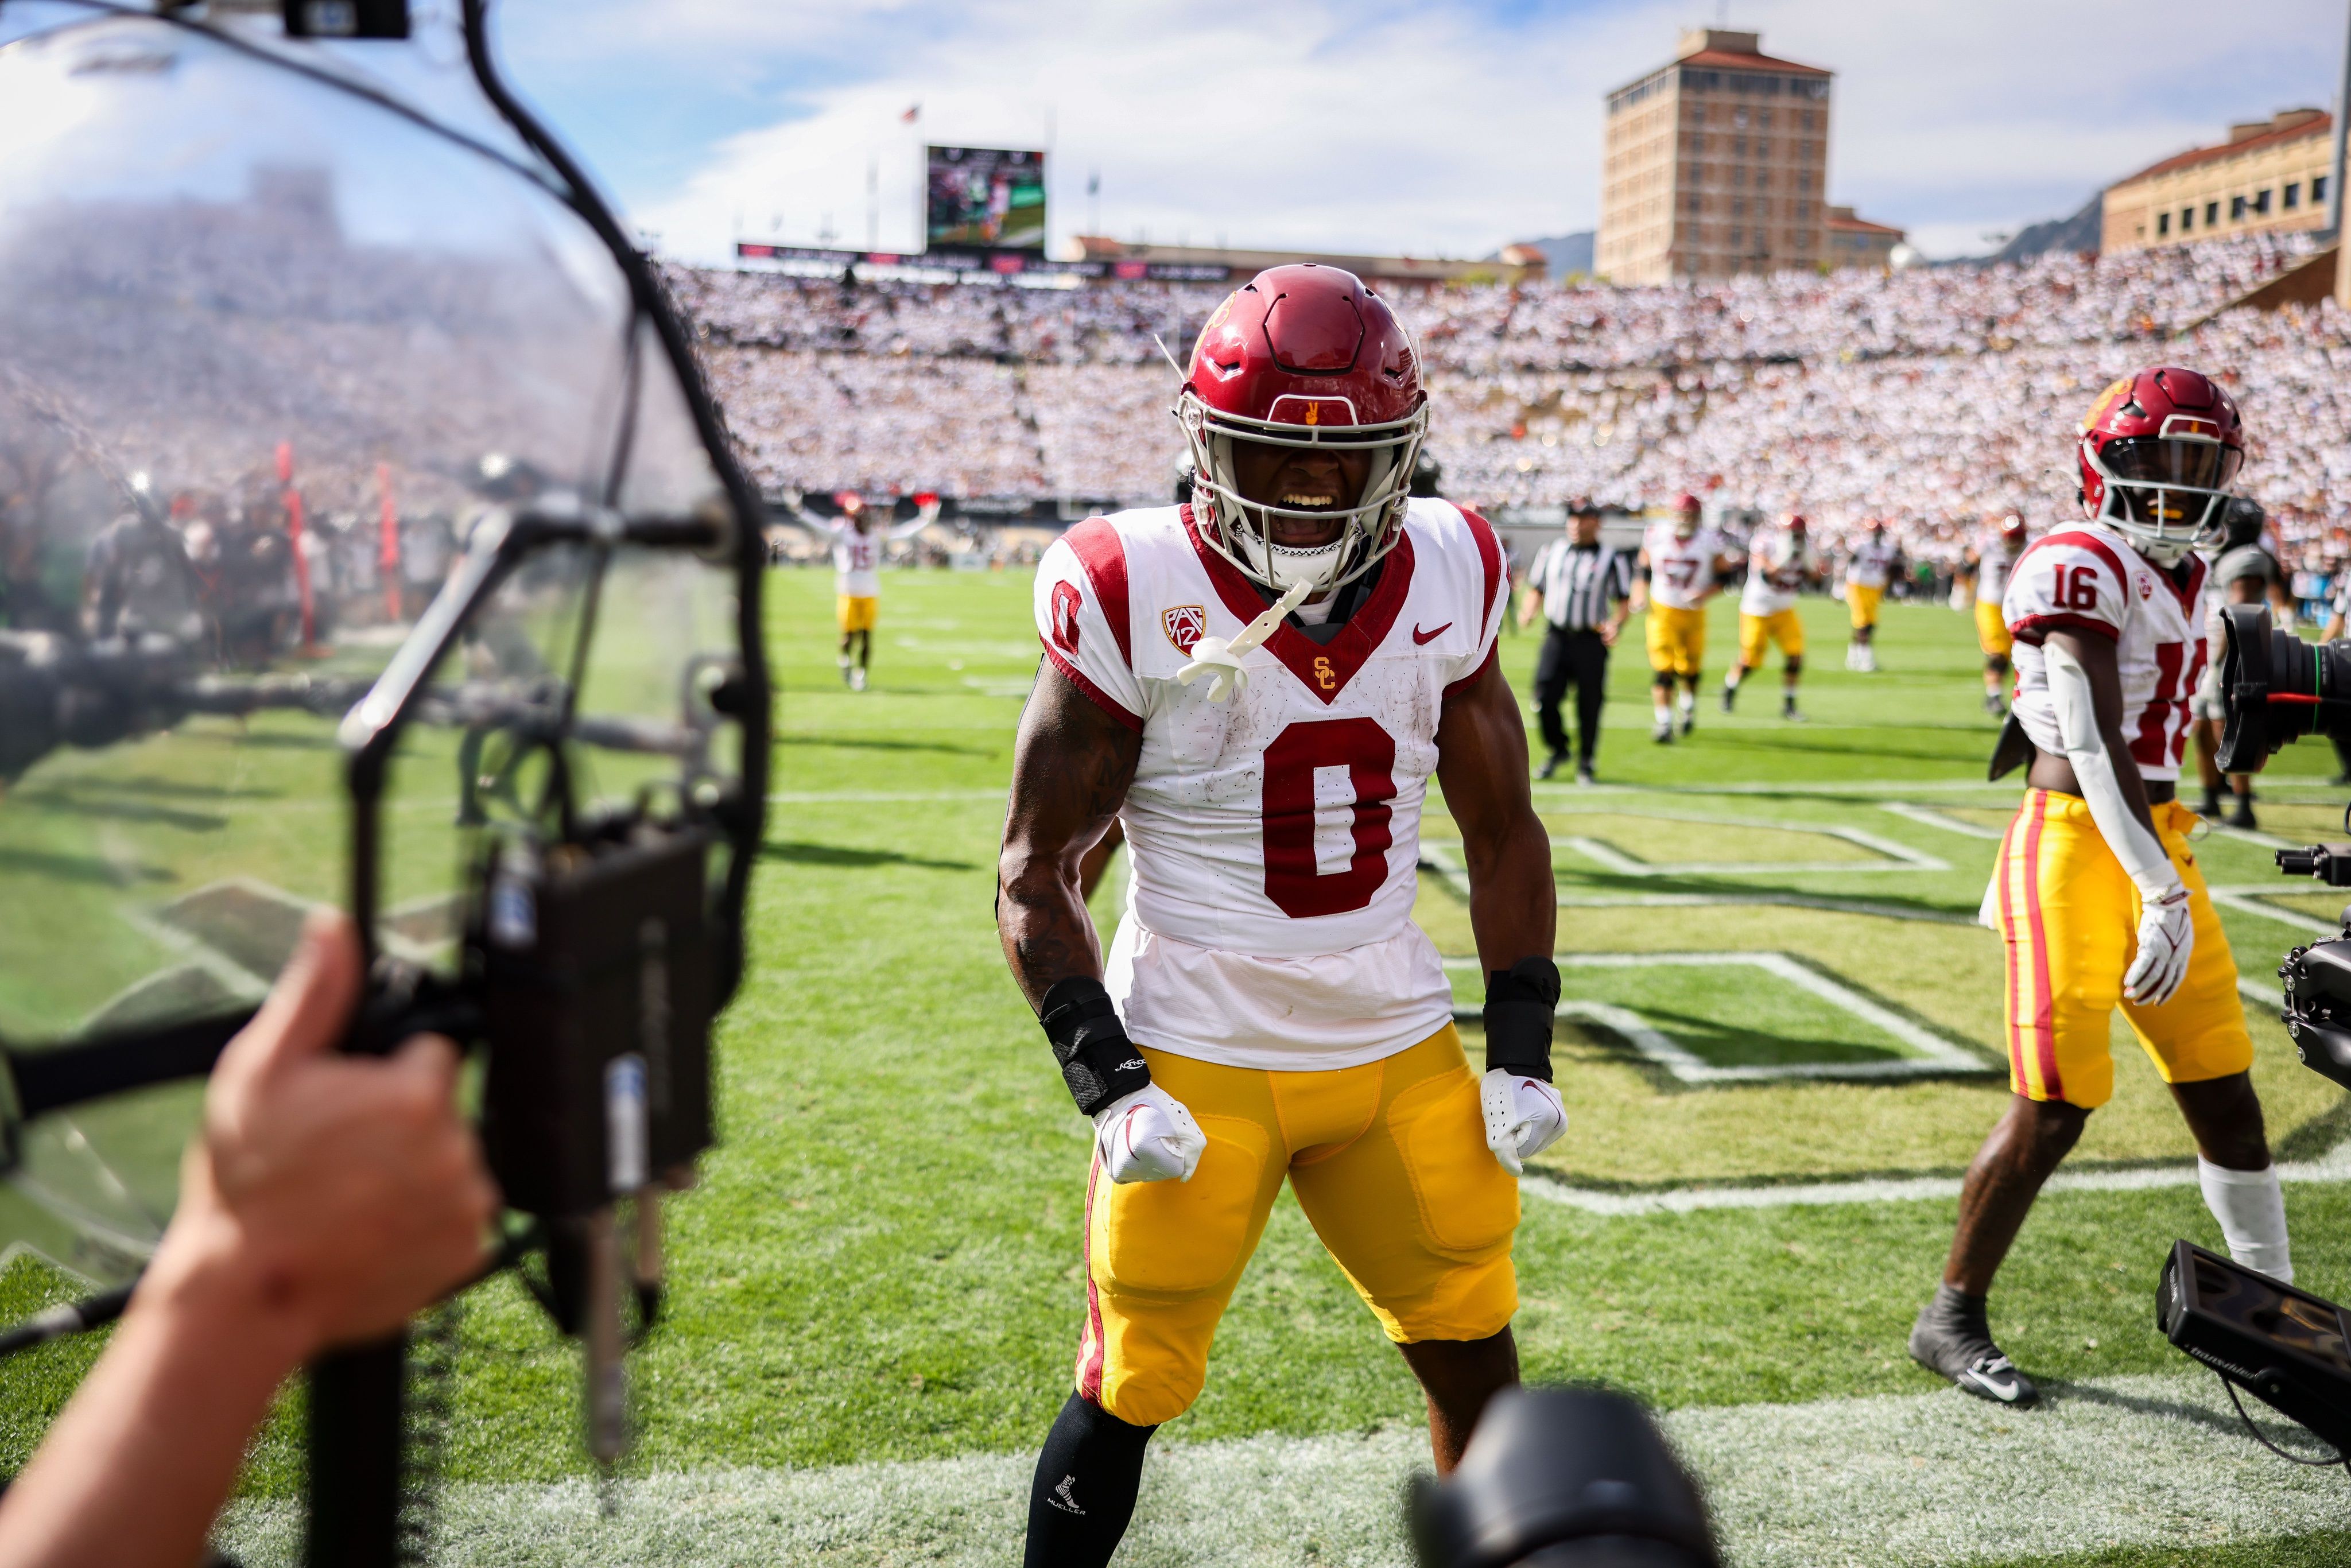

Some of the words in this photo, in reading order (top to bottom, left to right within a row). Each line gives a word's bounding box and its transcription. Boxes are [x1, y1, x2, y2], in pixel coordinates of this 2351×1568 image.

[2053, 564, 2097, 610] 16
[1052, 580, 1082, 655] 0
[1165, 607, 1203, 639] PAC
[1177, 626, 1198, 646] 12
[1262, 716, 1396, 919] 0
[1047, 1497, 1086, 1515] MUELLER
